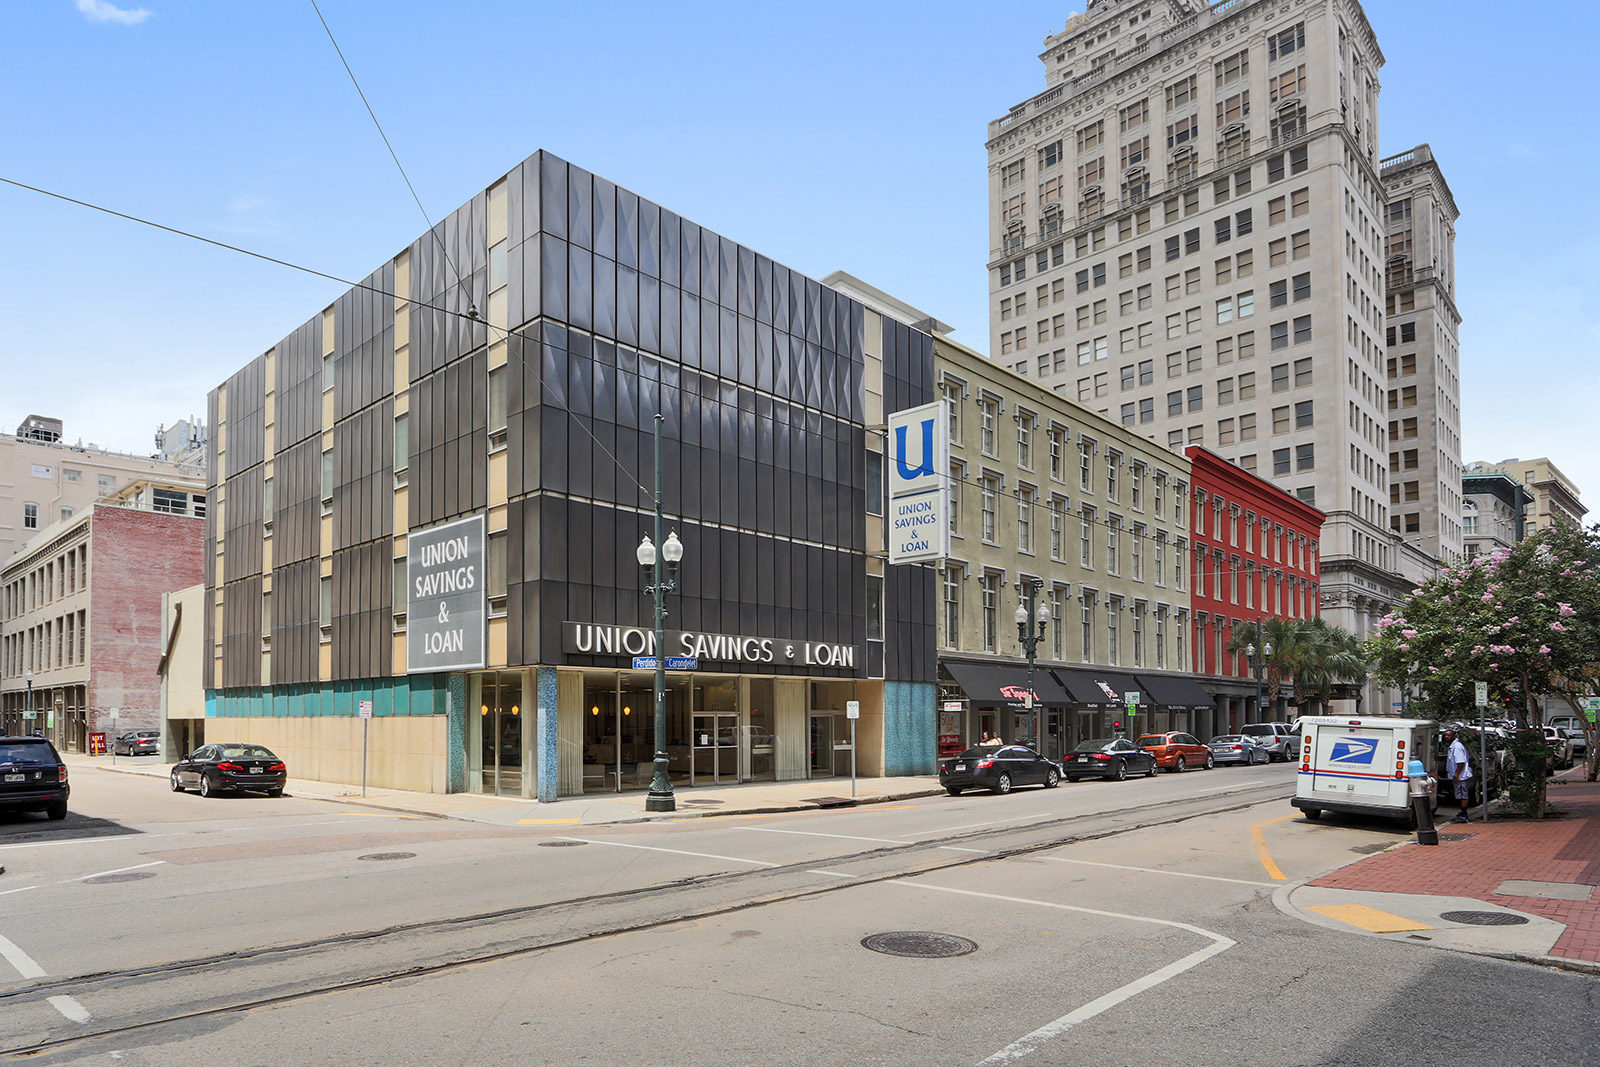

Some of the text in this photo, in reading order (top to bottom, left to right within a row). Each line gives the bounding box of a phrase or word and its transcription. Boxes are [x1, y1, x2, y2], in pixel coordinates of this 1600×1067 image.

[898, 501, 932, 515] UNION
[894, 513, 936, 530] SAVINGS
[910, 529, 919, 540] &
[421, 536, 468, 567] UNION
[901, 540, 929, 553] LOAN
[415, 565, 475, 598] SAVINGS
[438, 601, 450, 624] &
[424, 629, 464, 655] LOAN
[680, 633, 774, 663] SAVINGS
[785, 645, 796, 659] &
[805, 642, 854, 667] LOAN
[668, 658, 696, 669] Carondelet
